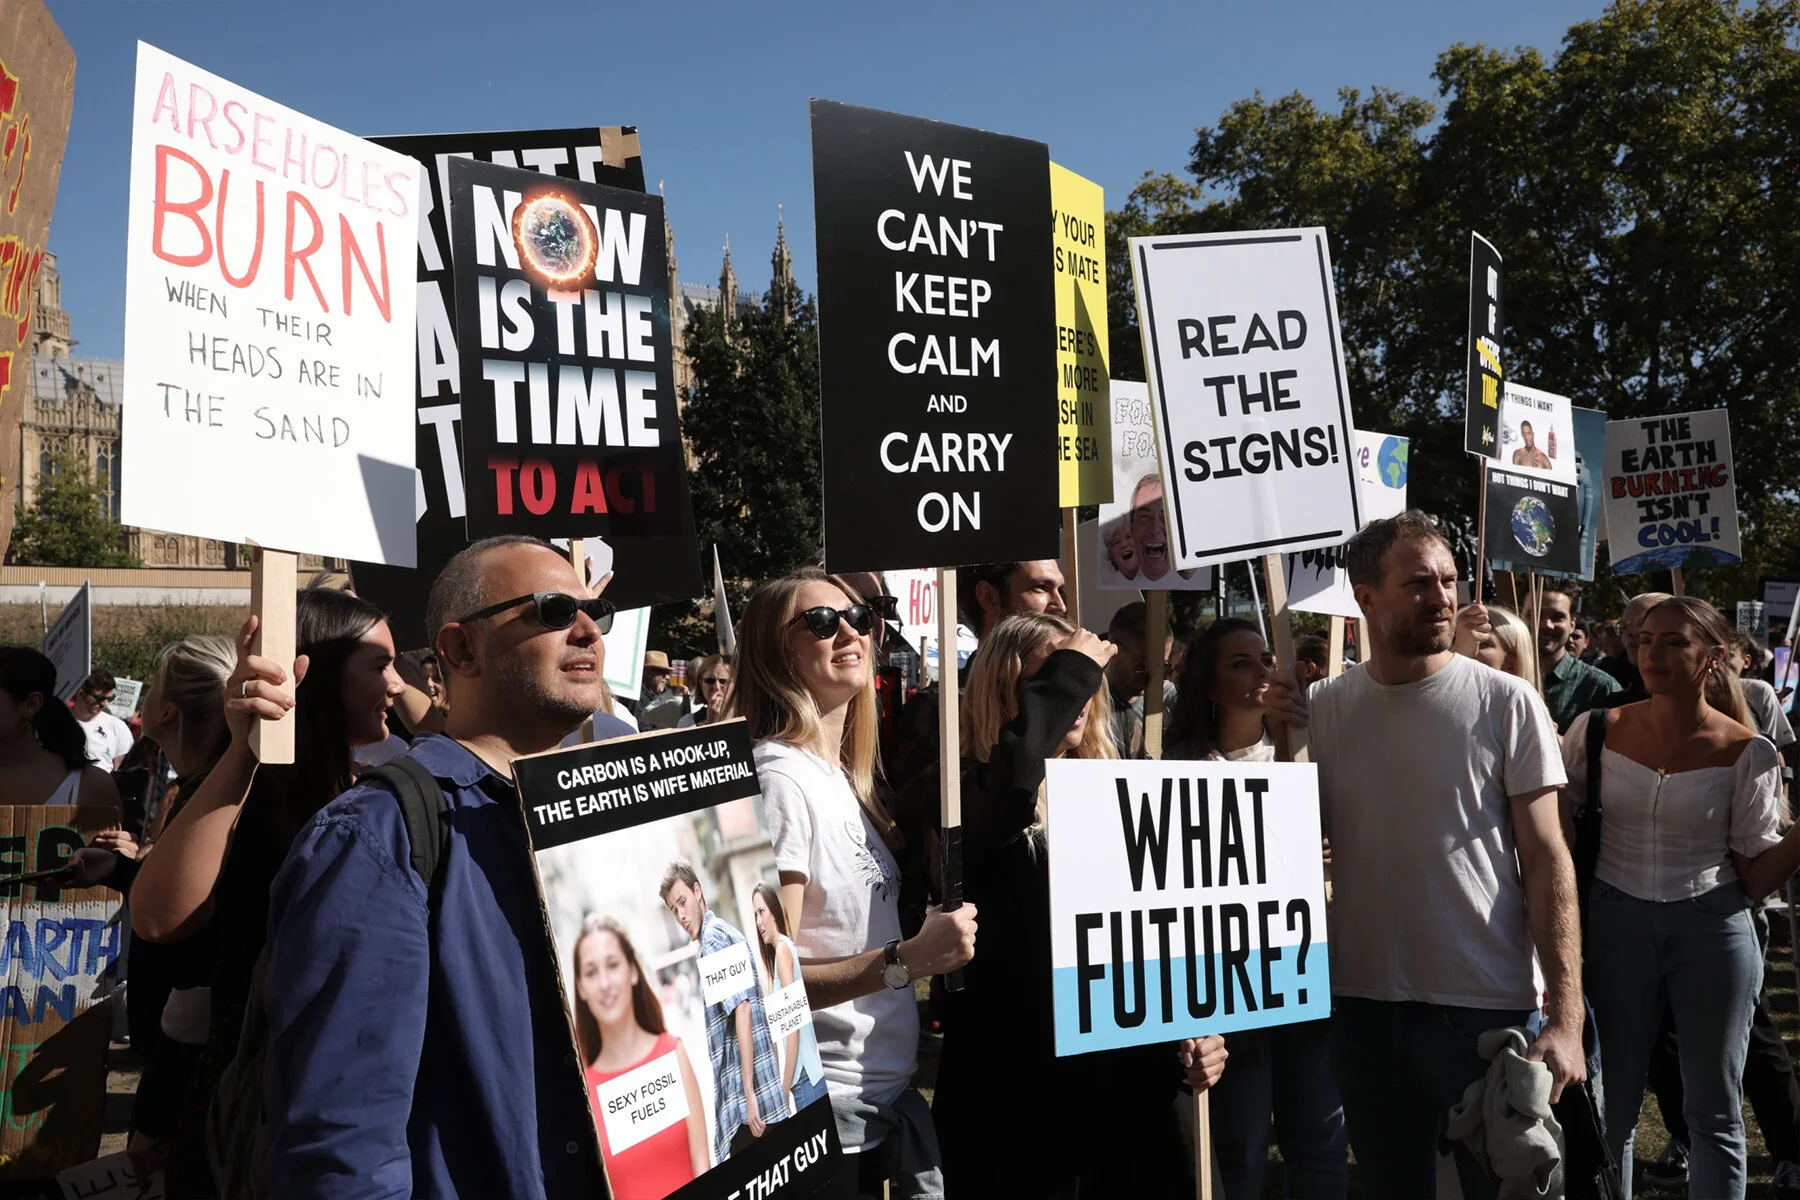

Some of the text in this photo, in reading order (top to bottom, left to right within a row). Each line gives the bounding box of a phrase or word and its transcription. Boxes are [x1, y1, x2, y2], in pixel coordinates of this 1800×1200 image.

[152, 72, 412, 219] ARSEHOLES
[904, 150, 973, 201] WE
[152, 144, 391, 324] BURN
[877, 209, 1003, 262] CAN'T
[1062, 212, 1095, 249] YOUR
[1068, 250, 1099, 284] MATE
[165, 276, 228, 319] WHEN
[895, 271, 992, 319] KEEP
[257, 307, 332, 347] THEIR
[478, 274, 535, 353] IS
[547, 288, 656, 363] THE
[1177, 310, 1307, 360] READ
[887, 333, 1001, 378] CALM
[1056, 326, 1095, 357] ERE'S
[188, 331, 383, 400] HEADS ARE IN
[1064, 363, 1098, 392] MORE
[482, 358, 661, 448] TIME
[926, 394, 968, 413] AND
[1081, 401, 1093, 426] IN
[1203, 369, 1301, 417] THE
[1511, 393, 1532, 408] THINGS
[1533, 400, 1536, 408] I
[1537, 400, 1553, 413] WANT
[156, 382, 351, 449] THE SAND
[1641, 417, 1691, 444] THE
[880, 431, 1013, 474] CARRY
[1075, 436, 1099, 461] SEA
[1183, 425, 1340, 483] SIGNS!
[1622, 440, 1717, 473] EARTH
[487, 455, 557, 516] TO
[570, 455, 661, 516] ACT
[1492, 472, 1568, 498] HOT THINGS I DON'T WANT
[1610, 463, 1729, 499] BURNING
[916, 491, 981, 532] ON
[1637, 492, 1710, 523] ISN'T
[1638, 517, 1720, 547] COOL!
[557, 740, 731, 790] CARBON IS A HOOK-UP,
[533, 761, 753, 825] THE EARTH IS WIFE MATERIAL
[1115, 778, 1269, 892] WHAT
[705, 960, 747, 987] THAT GUY
[1075, 898, 1311, 1034] FUTURE?
[768, 996, 808, 1025] SUSTAINABLE
[784, 992, 789, 1001] A
[780, 1014, 803, 1032] PLANET
[608, 1072, 677, 1114] SEXY FOSSIL
[631, 1097, 666, 1124] FUELS
[745, 1129, 827, 1200] THAT GUY
